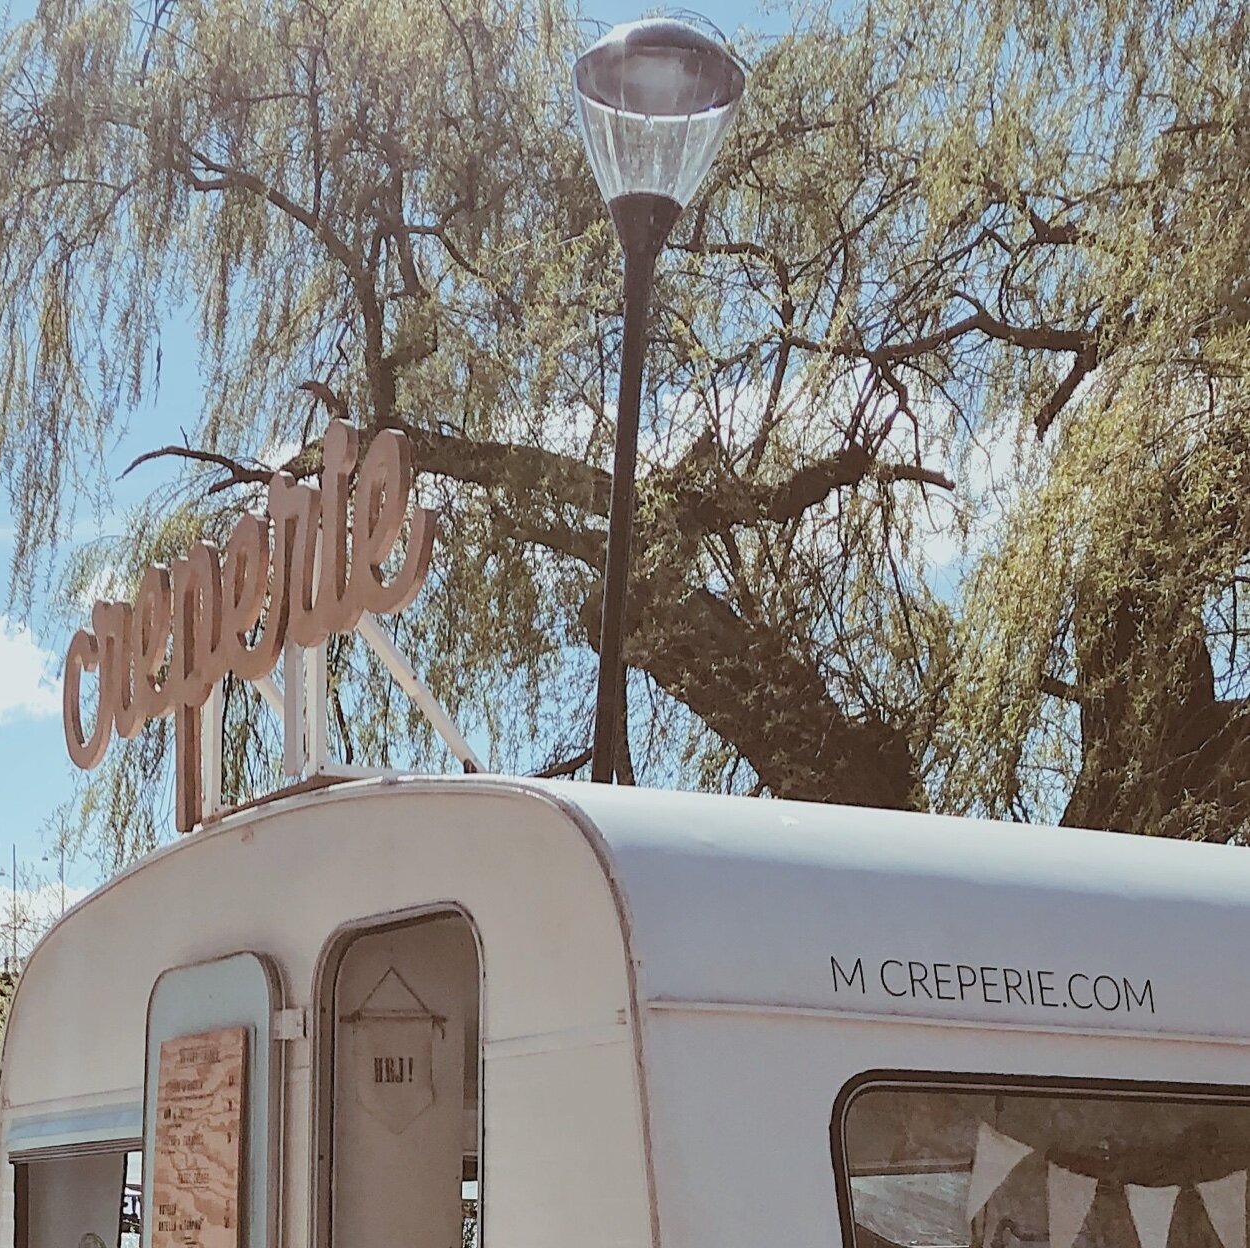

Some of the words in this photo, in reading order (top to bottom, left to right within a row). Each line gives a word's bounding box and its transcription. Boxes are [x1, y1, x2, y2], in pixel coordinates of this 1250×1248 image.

[63, 418, 438, 832] creperie
[830, 955, 866, 995] M
[880, 959, 1156, 1014] CREPERIE.COM
